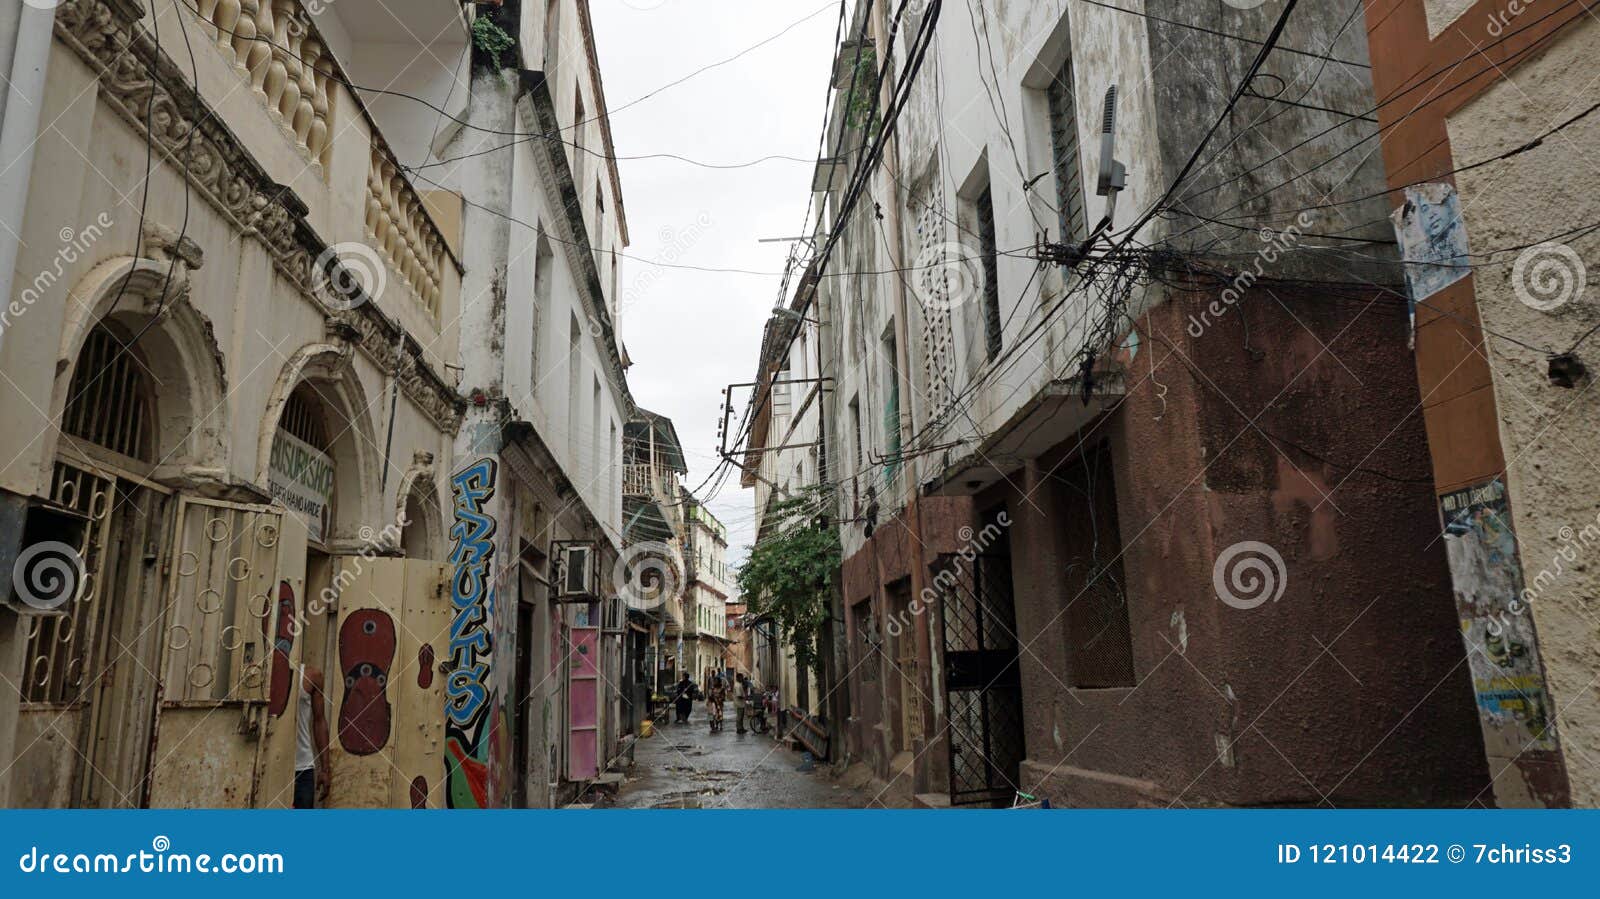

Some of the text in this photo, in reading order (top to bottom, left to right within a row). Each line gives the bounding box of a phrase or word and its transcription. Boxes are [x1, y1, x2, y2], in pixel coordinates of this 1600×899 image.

[304, 498, 321, 518] MADE
[1443, 495, 1456, 511] NO
[1456, 492, 1469, 508] TO
